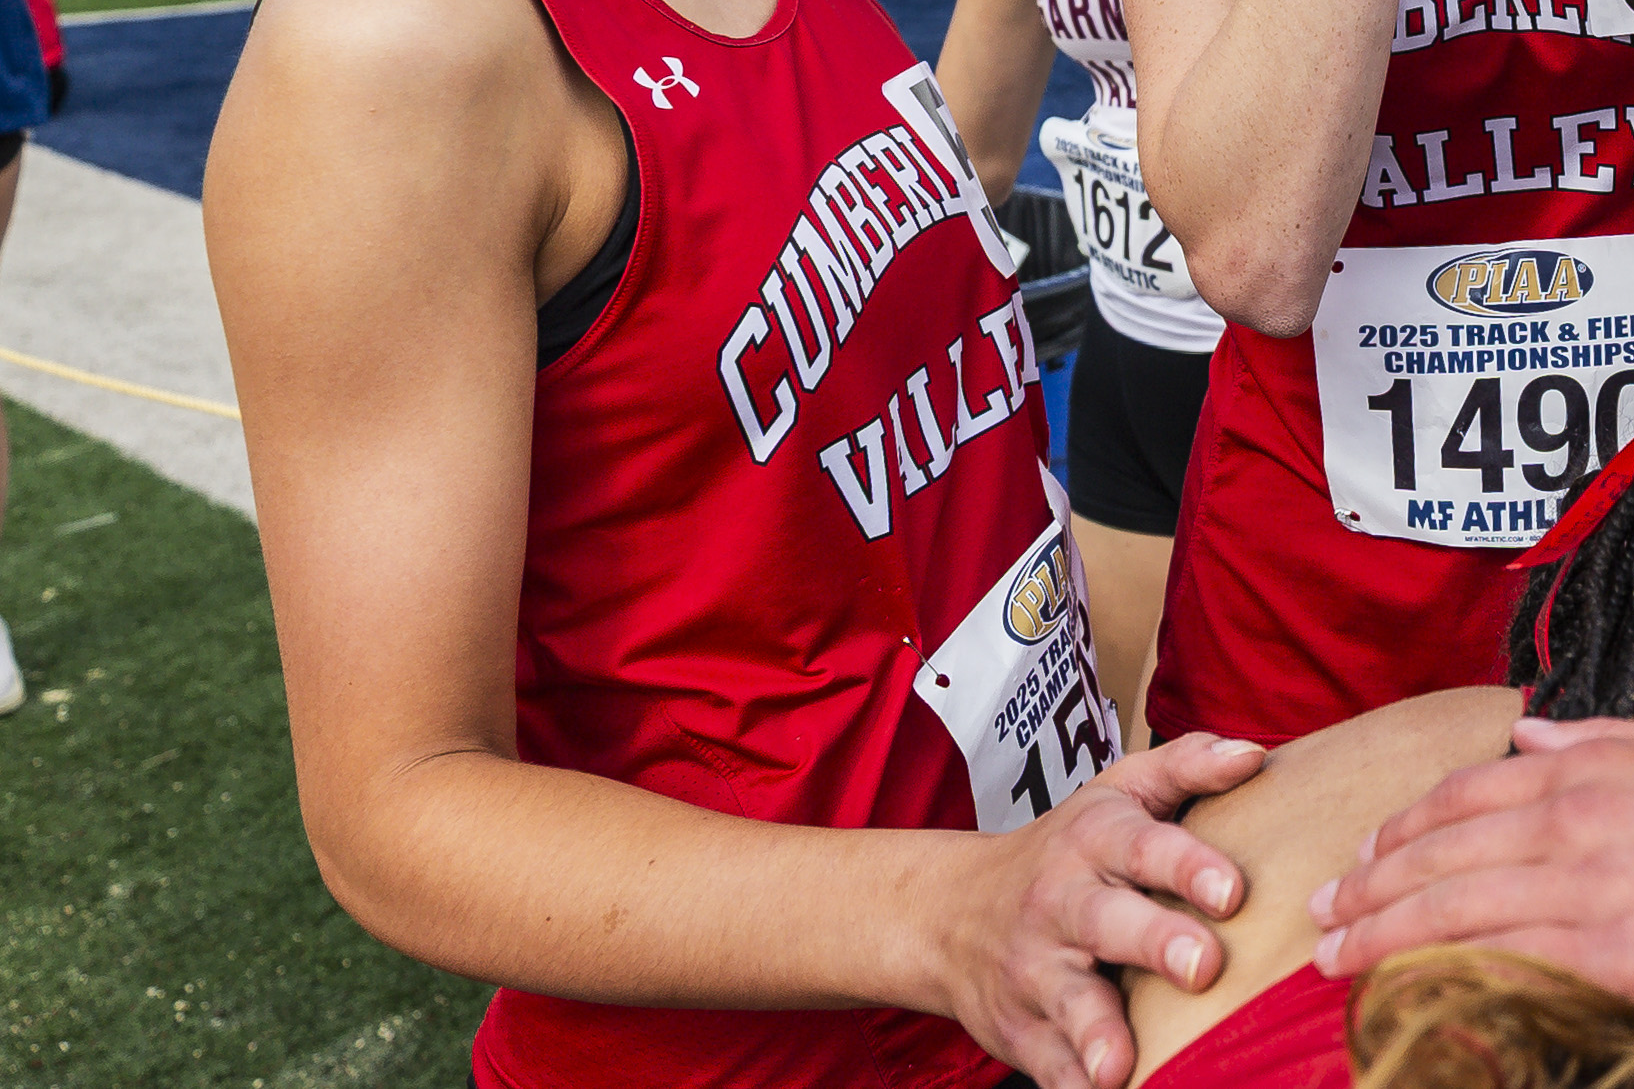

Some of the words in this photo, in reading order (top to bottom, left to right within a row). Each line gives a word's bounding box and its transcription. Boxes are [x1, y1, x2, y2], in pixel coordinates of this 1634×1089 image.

[1073, 169, 1174, 272] 1612
[716, 124, 968, 466] CUMBERL
[1451, 256, 1583, 305] PIAA
[1358, 324, 1439, 348] 2025
[1447, 320, 1550, 347] TRACK
[1558, 322, 1580, 342] &
[1407, 499, 1455, 530] MF
[1461, 499, 1562, 532] ATHL
[1011, 543, 1068, 637] PIA
[994, 668, 1040, 743] 2025
[1038, 628, 1074, 676] TRA
[1015, 648, 1081, 751] CHAMPI
[1011, 661, 1112, 819] 15
